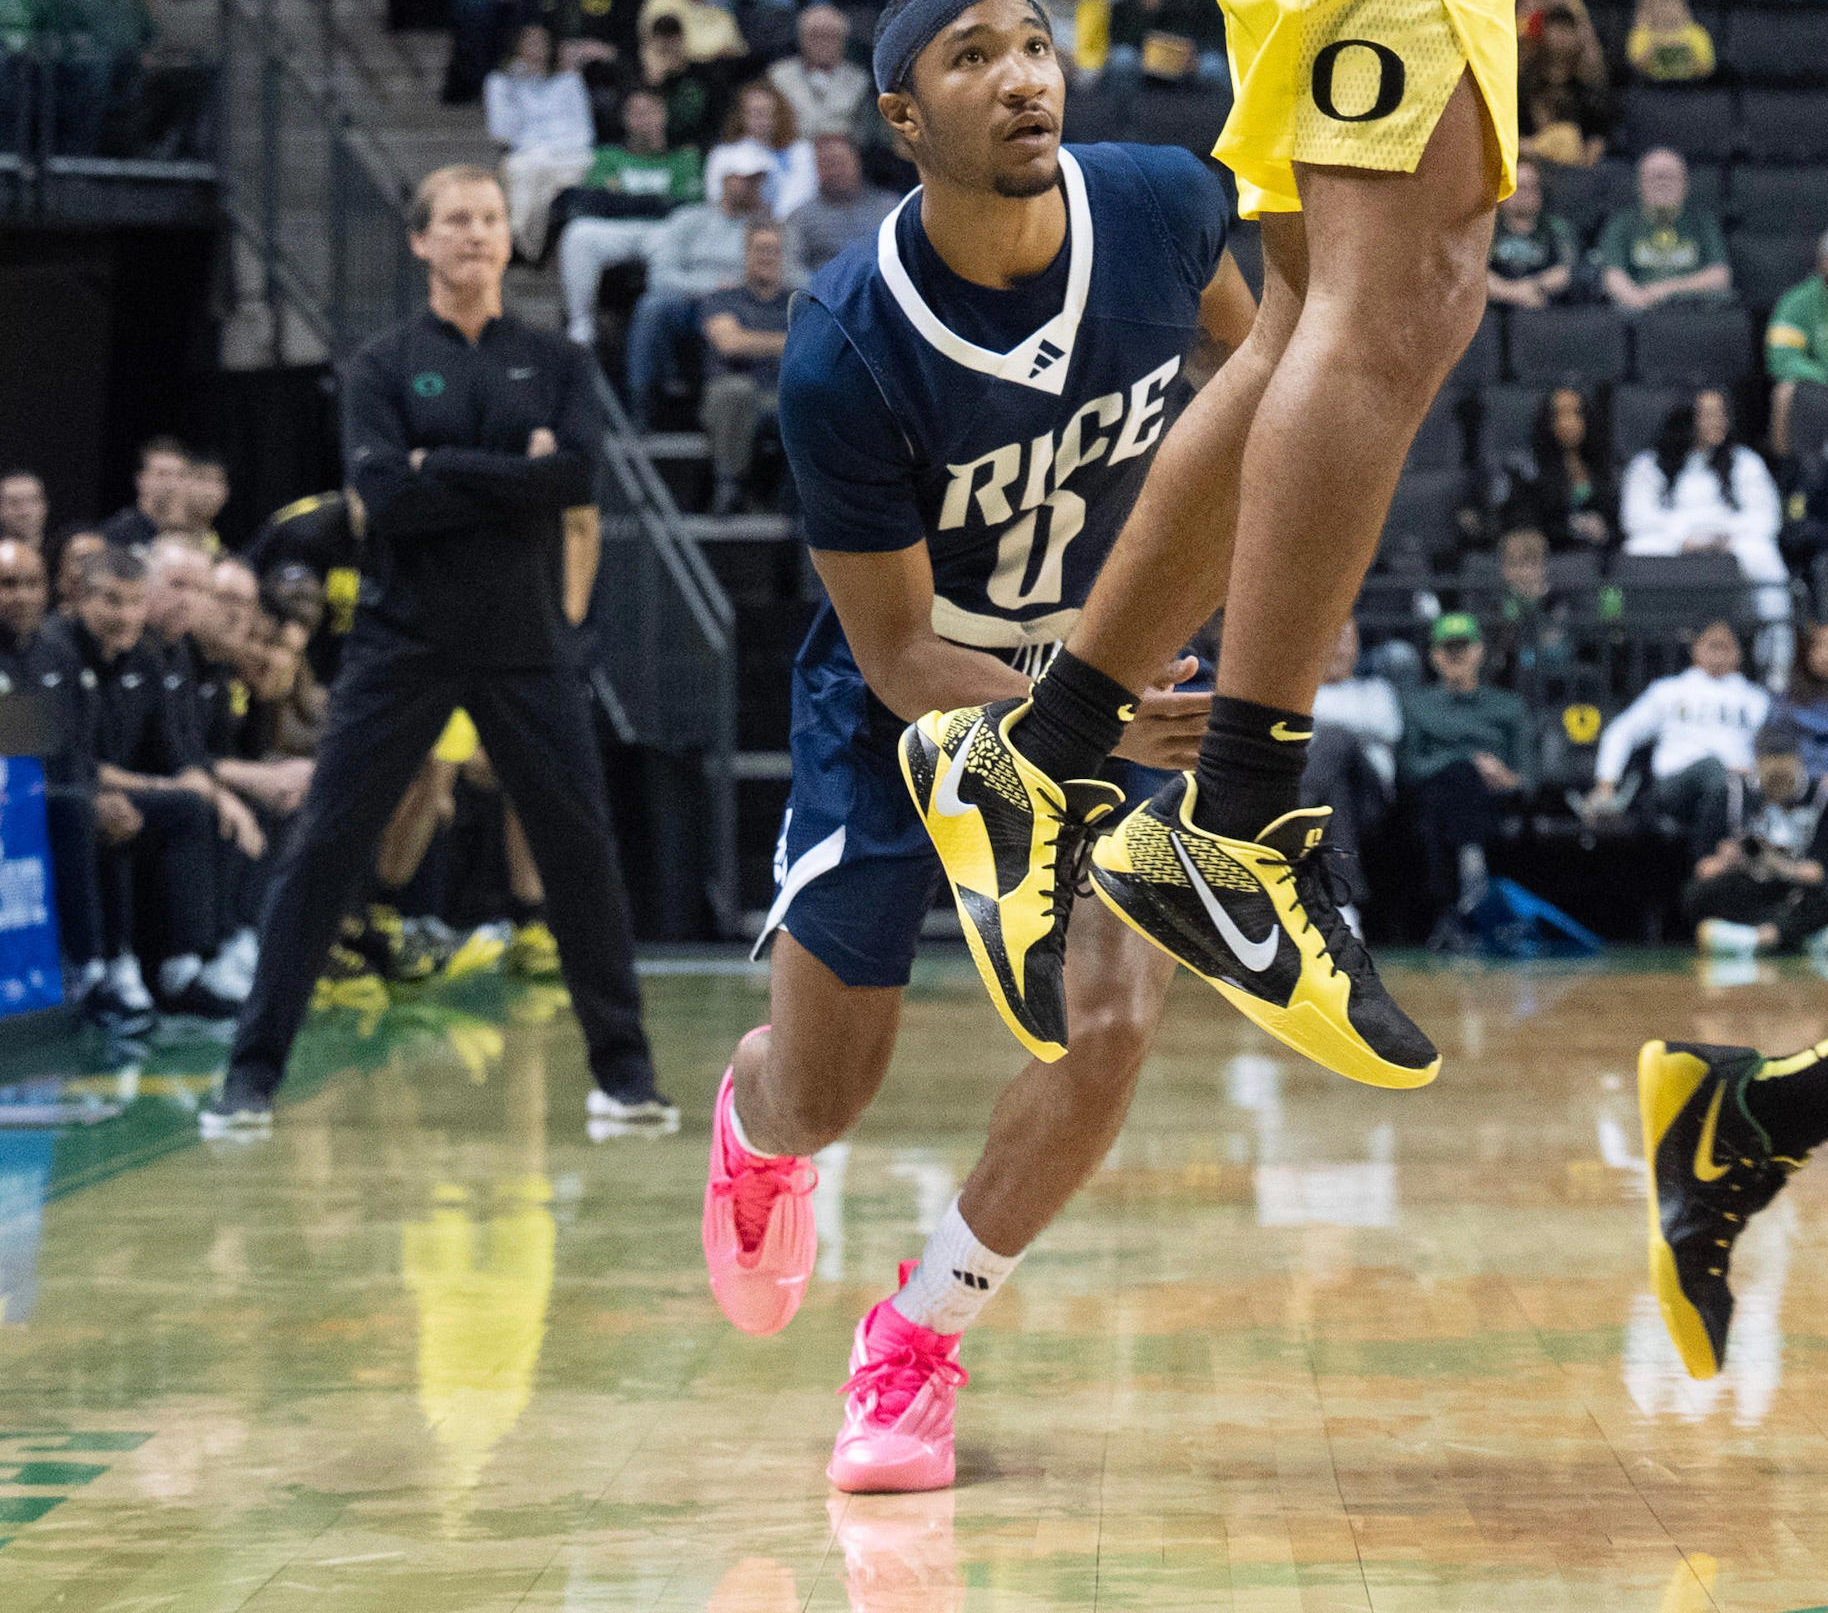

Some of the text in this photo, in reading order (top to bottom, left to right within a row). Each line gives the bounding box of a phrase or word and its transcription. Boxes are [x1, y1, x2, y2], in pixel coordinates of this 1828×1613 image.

[1312, 39, 1405, 122] O
[938, 355, 1180, 531] RICE
[987, 489, 1086, 610] 0
